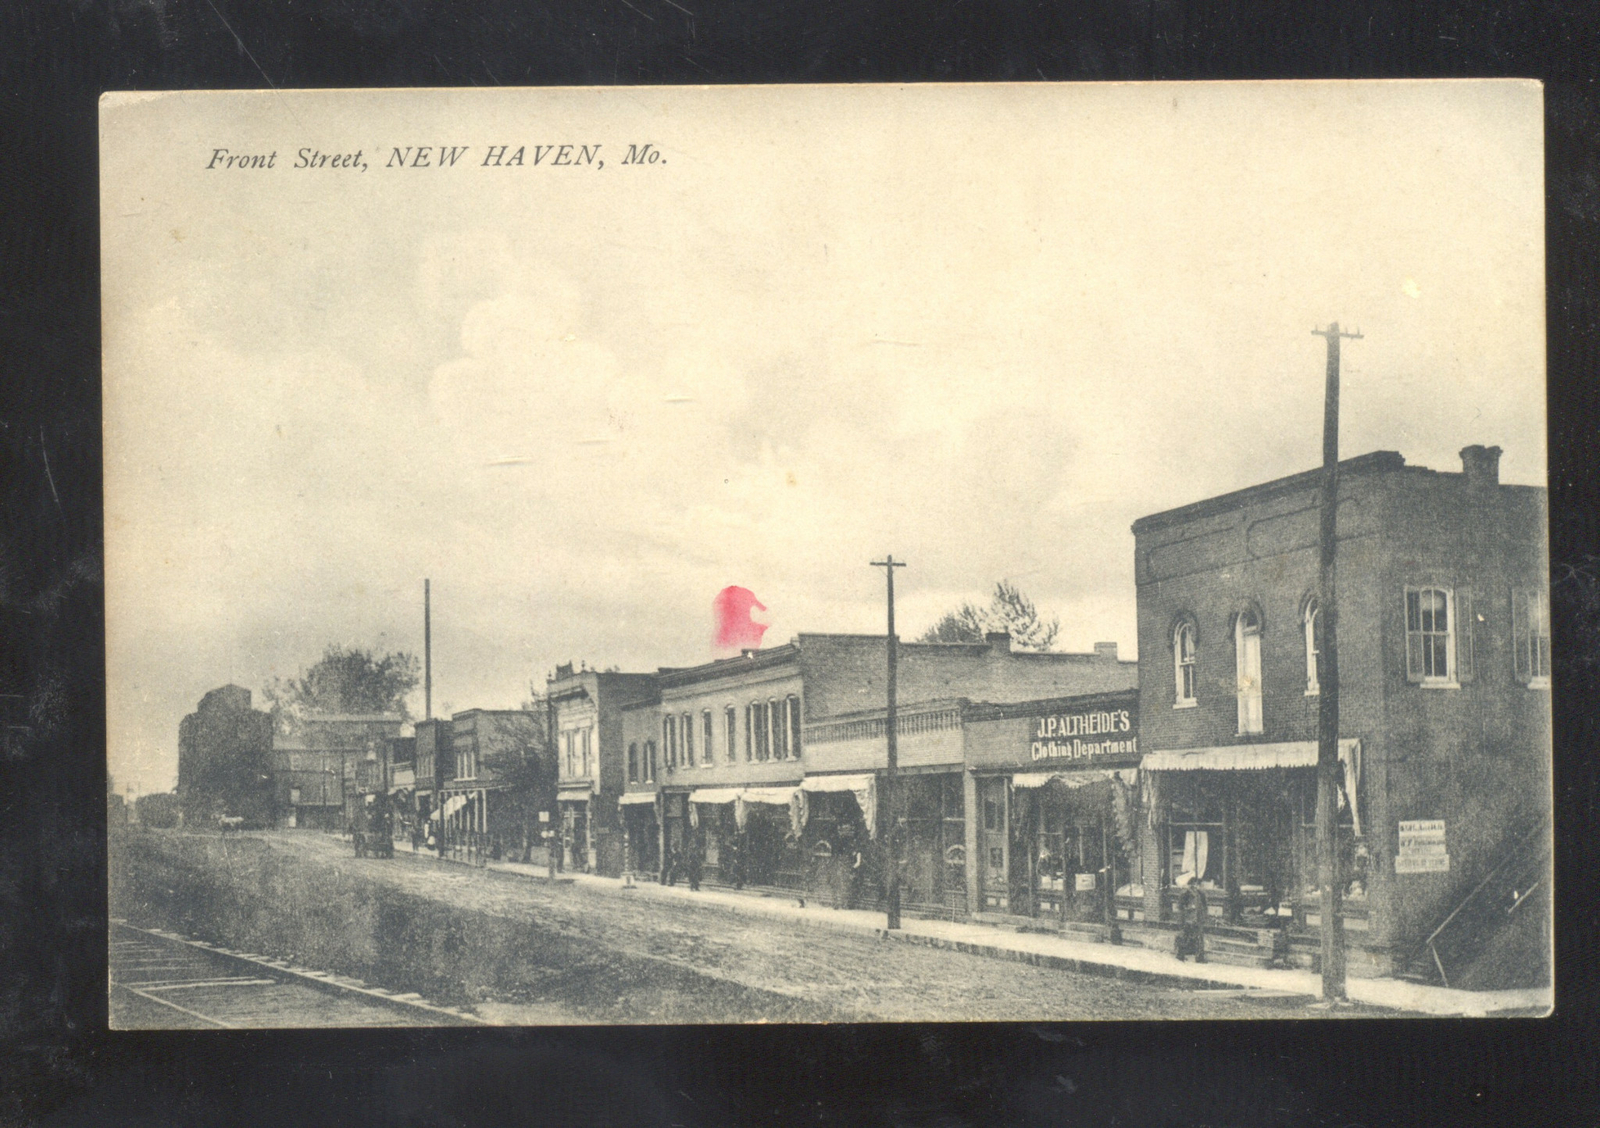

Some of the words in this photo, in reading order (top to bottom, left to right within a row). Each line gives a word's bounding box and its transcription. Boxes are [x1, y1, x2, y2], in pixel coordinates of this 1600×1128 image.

[1058, 709, 1131, 737] ALTHEIDE'S
[1031, 740, 1072, 761] Clothing
[1073, 736, 1138, 760] Department
